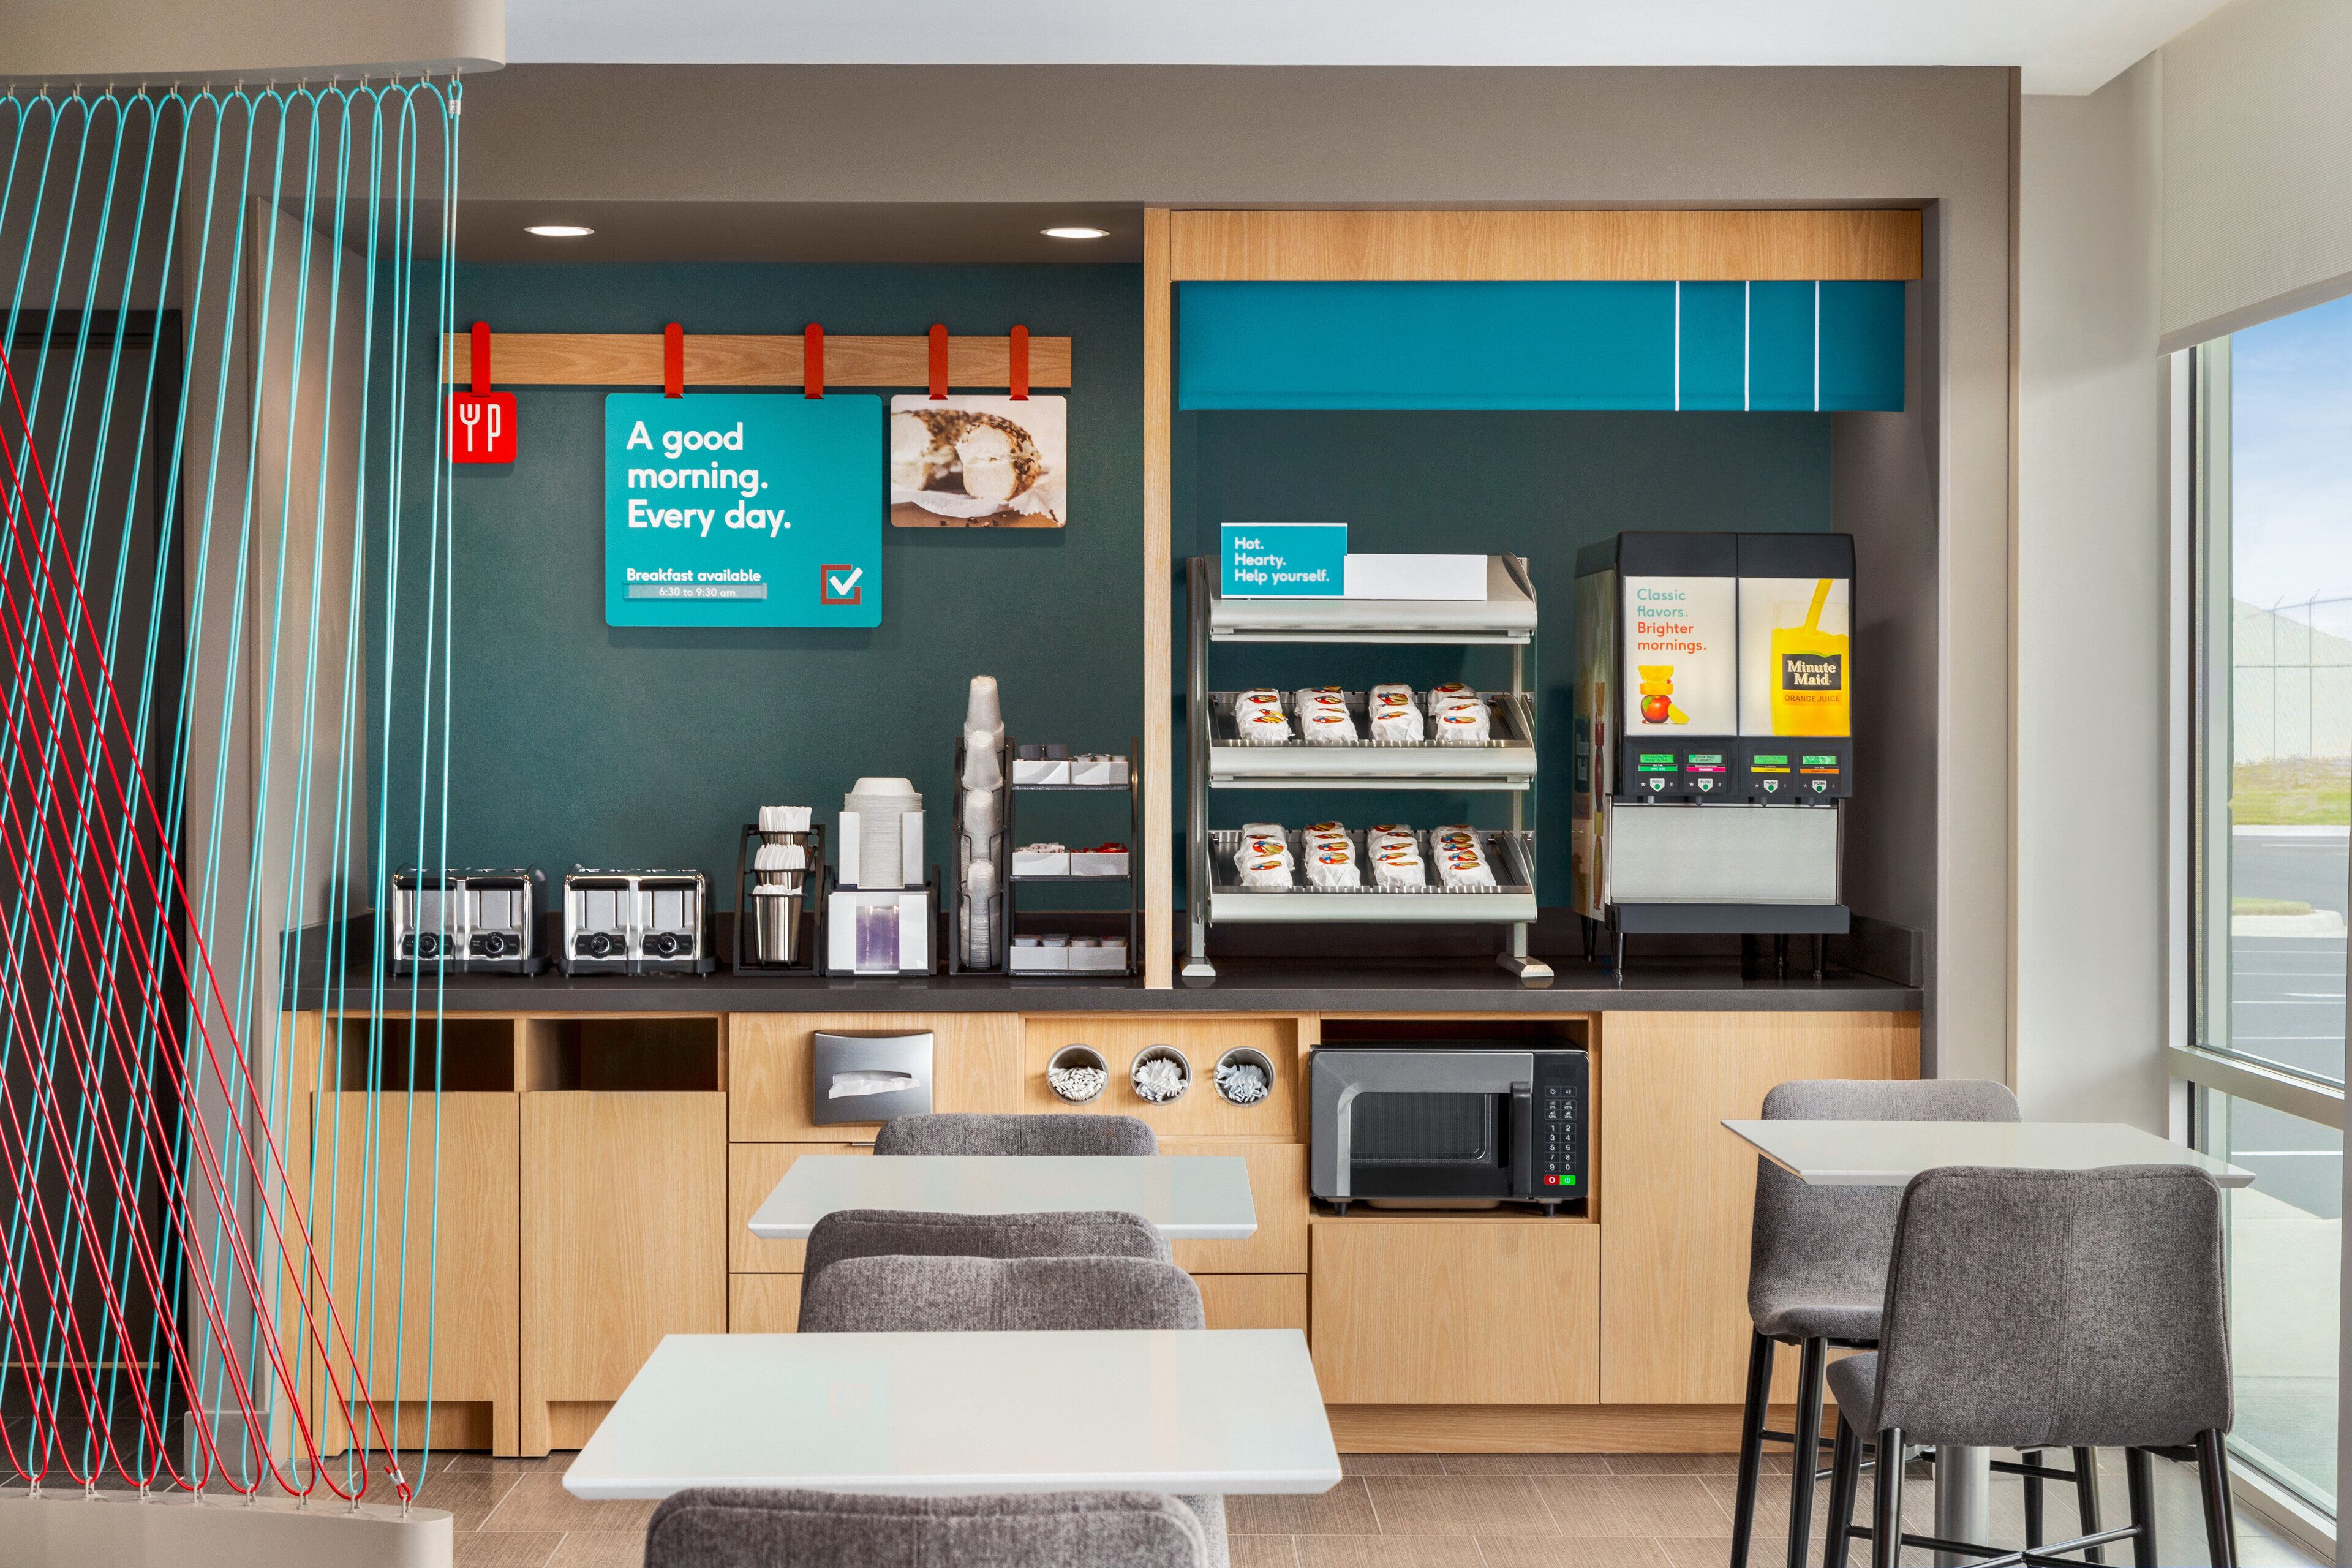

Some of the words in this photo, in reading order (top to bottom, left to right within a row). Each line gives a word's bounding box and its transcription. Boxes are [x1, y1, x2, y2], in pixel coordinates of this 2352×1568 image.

[626, 421, 654, 450] A
[662, 421, 743, 459] good
[628, 461, 768, 498] morning.
[628, 499, 715, 537] Every
[725, 499, 791, 538] day.
[1235, 537, 1264, 549] Hot.
[1235, 552, 1286, 570] Hearty.
[627, 568, 693, 581] Breakfast
[698, 568, 761, 582] available
[1235, 568, 1268, 586] Help
[1272, 568, 1330, 586] yourself.
[658, 587, 680, 597] 6:30
[683, 588, 693, 597] to
[696, 587, 717, 597] 9:30
[1637, 588, 1686, 600] Classic
[1637, 605, 1688, 617] flavors.
[1638, 622, 1694, 637] Brighter
[1638, 639, 1706, 654] mornings.
[1787, 660, 1836, 673] Minute
[1794, 673, 1831, 685] Maid
